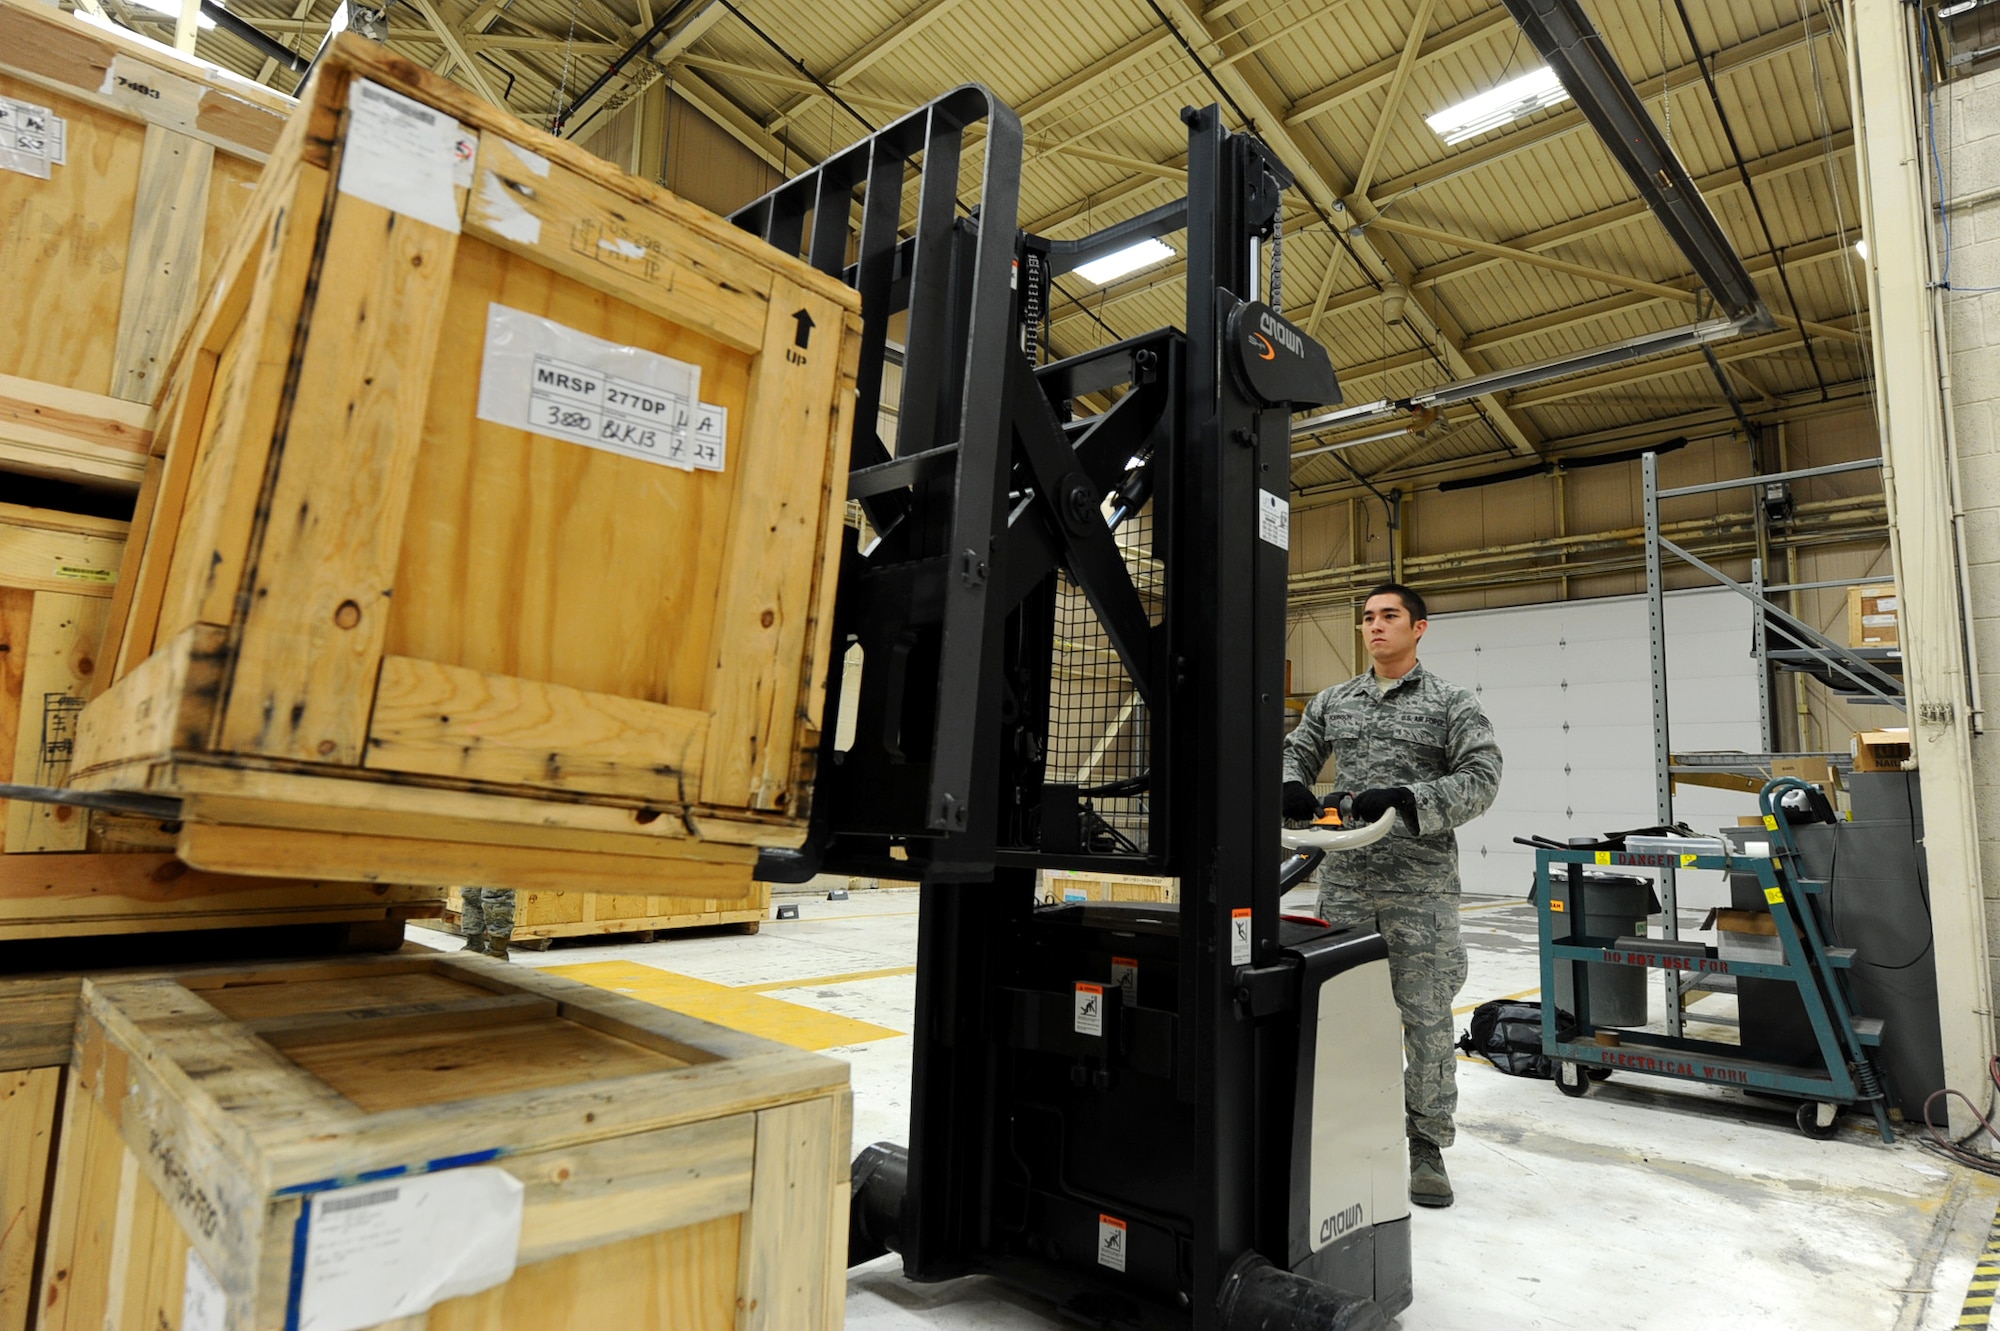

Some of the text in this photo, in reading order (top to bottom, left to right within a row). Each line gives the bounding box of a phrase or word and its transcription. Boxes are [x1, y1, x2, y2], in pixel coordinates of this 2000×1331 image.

[1260, 311, 1305, 359] CROWN
[786, 348, 807, 367] UP
[537, 368, 666, 415] MRSP 277DP
[1425, 717, 1446, 728] FORCE
[1618, 853, 1676, 866] DANGER
[1603, 949, 1729, 973] DO NOT USE FOR
[1601, 1051, 1748, 1083] ELECTRICAL WORK
[1320, 1203, 1363, 1244] CROWN
